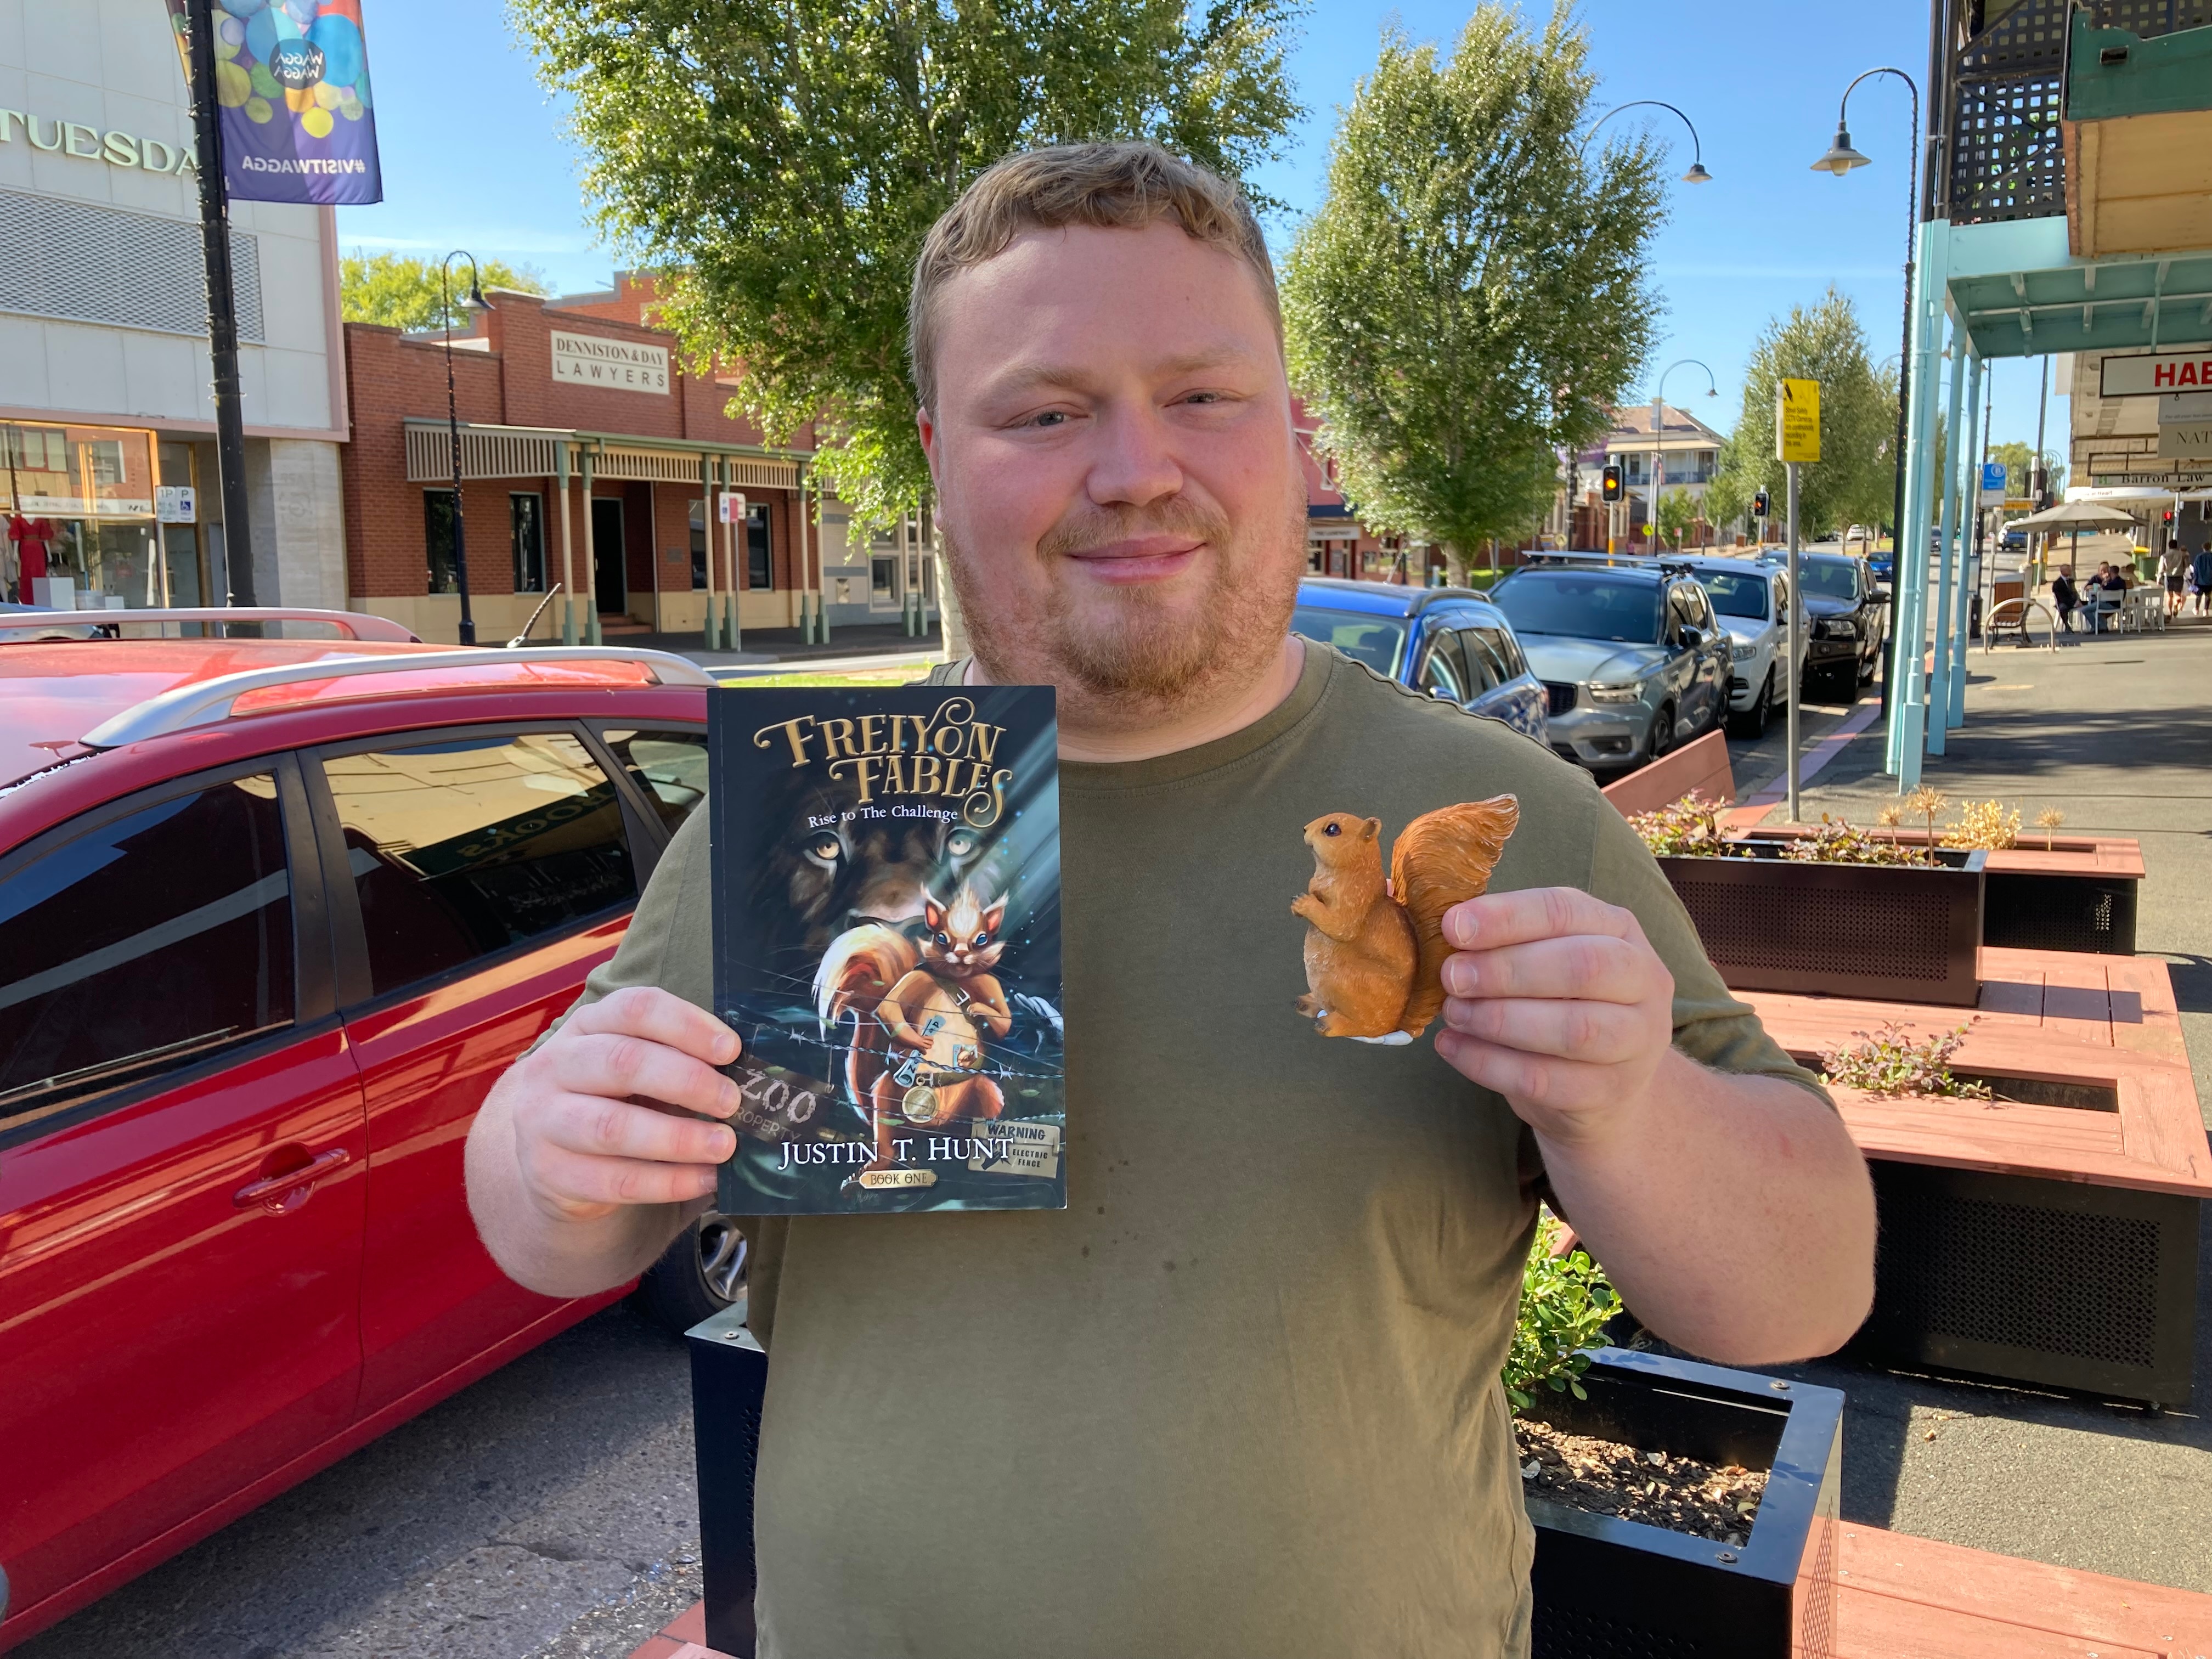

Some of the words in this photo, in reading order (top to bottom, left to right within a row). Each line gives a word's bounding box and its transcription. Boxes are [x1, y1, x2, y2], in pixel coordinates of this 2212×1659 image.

[557, 338, 629, 359] DENNISTON
[631, 349, 639, 361] &
[641, 351, 664, 365] DAY
[557, 360, 664, 387] LAWYERS
[2121, 473, 2169, 484] Barron
[2177, 473, 2205, 483] Law
[161, 489, 173, 498] 1P
[182, 489, 189, 498] P
[754, 697, 1007, 768] FREIYON
[829, 755, 1013, 828] FABLES
[808, 813, 837, 828] Rise
[842, 811, 856, 821] to
[860, 807, 887, 819] The
[891, 805, 958, 823] Challenge
[739, 1069, 816, 1123] ZOO
[734, 1107, 802, 1143] ROPERTY
[988, 1125, 1046, 1140] WARNING
[777, 1141, 878, 1170] JUSTIN
[892, 1138, 916, 1161] T.
[928, 1137, 1013, 1161] HUNT
[1013, 1149, 1048, 1159] ELECTRIC
[1018, 1159, 1040, 1167] FENCE
[871, 1174, 901, 1185] BOOK
[905, 1173, 928, 1184] ONE
